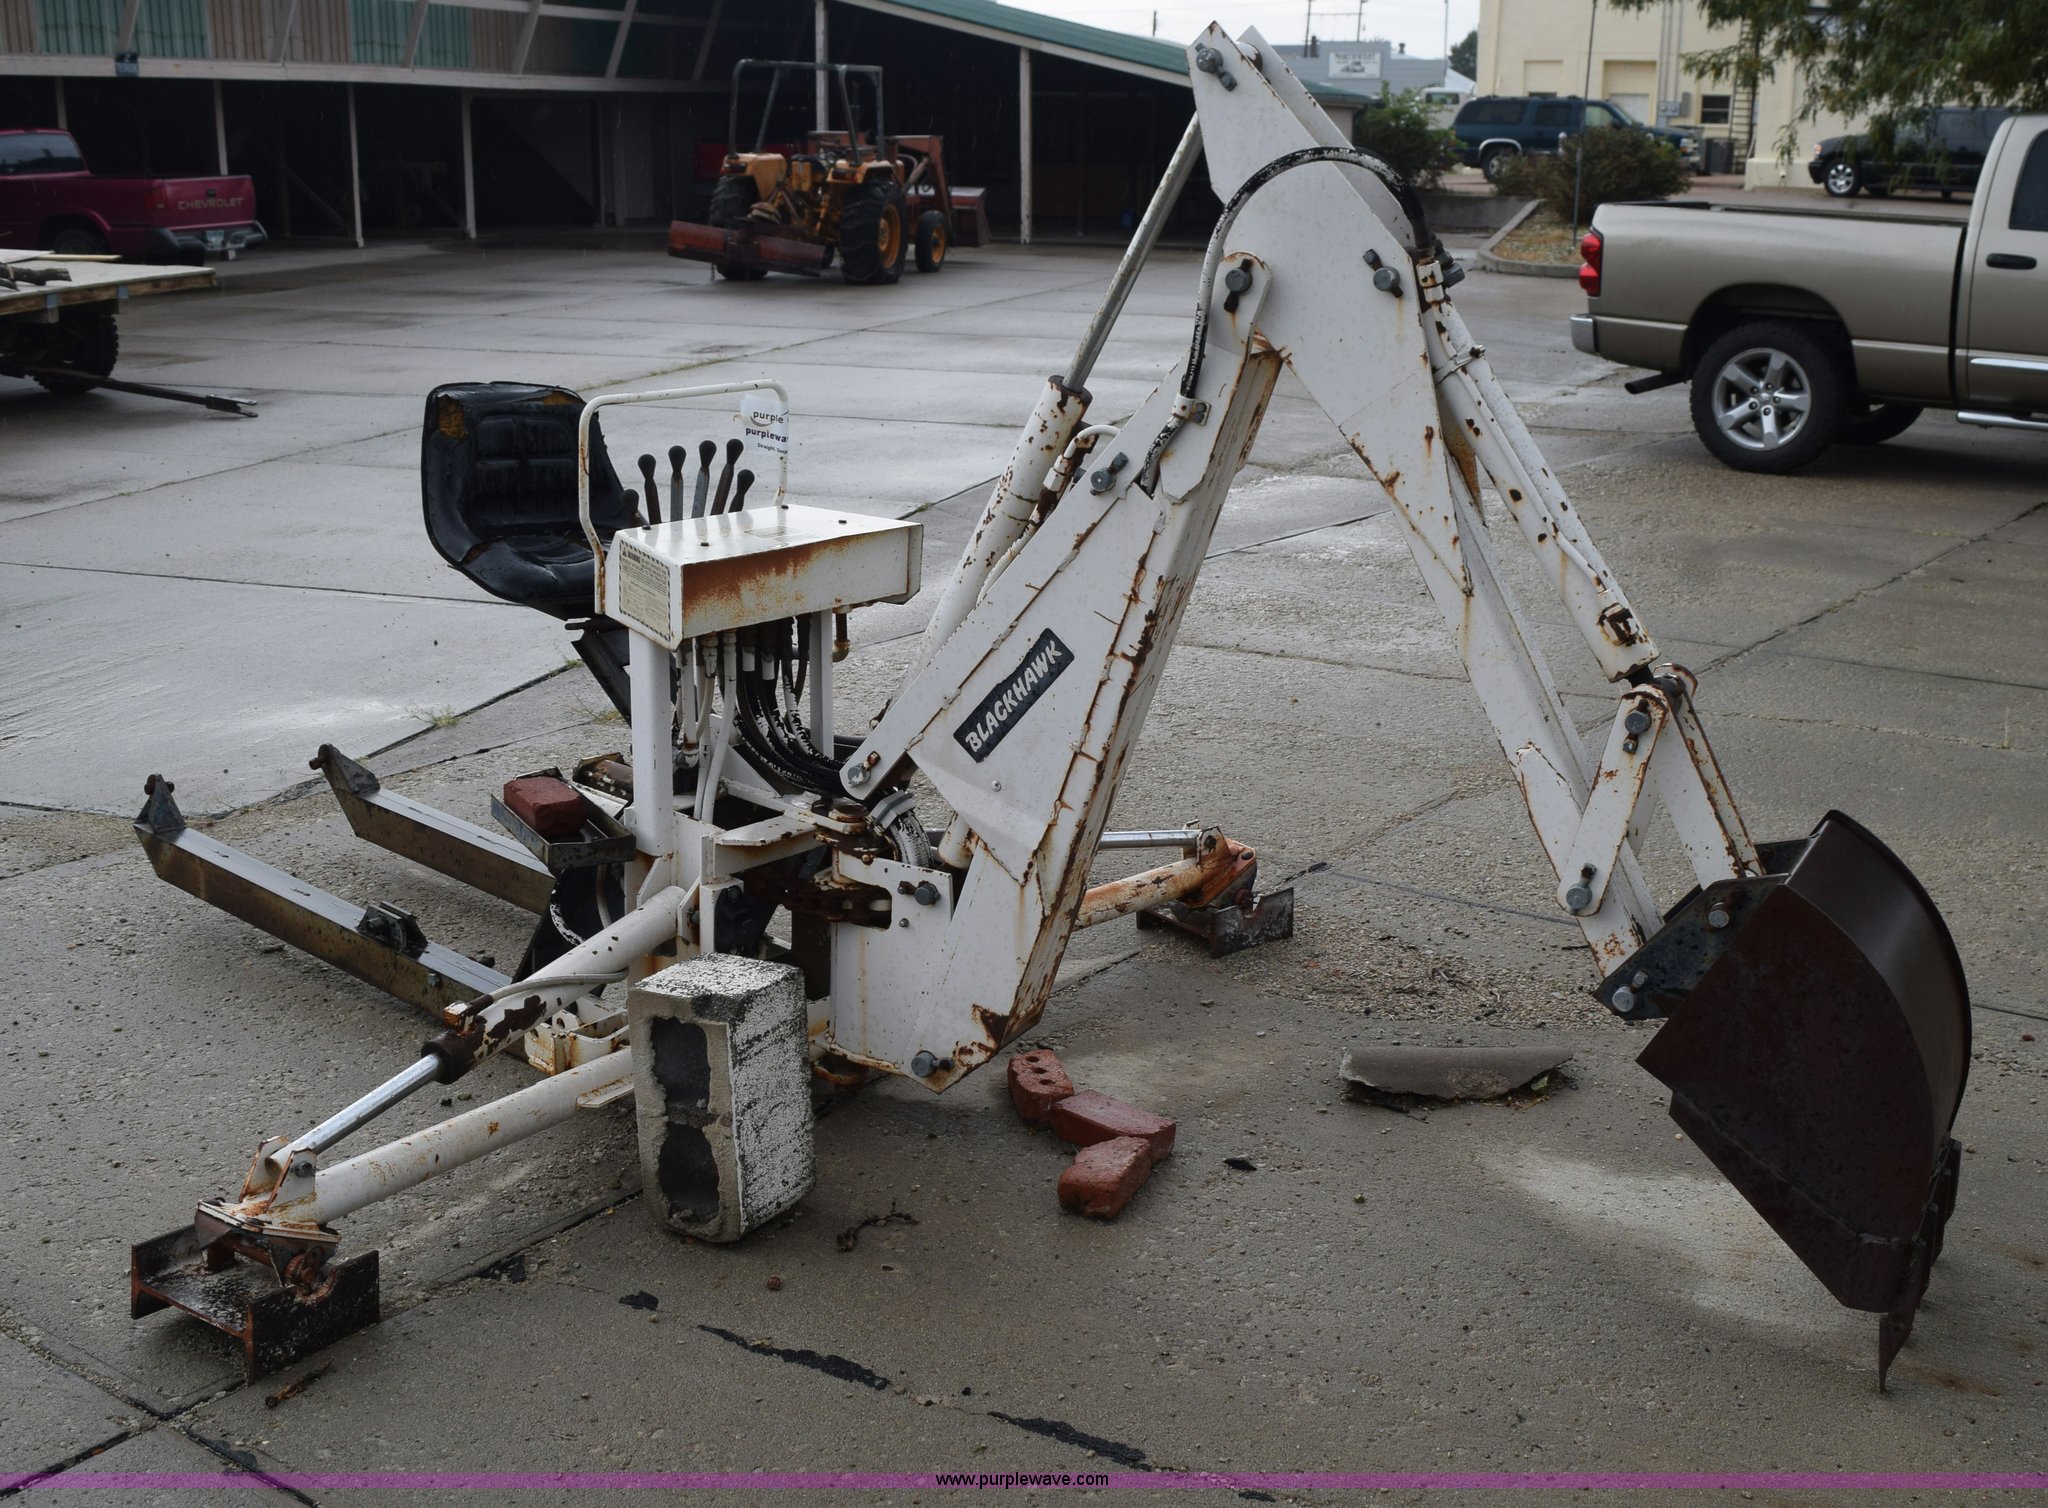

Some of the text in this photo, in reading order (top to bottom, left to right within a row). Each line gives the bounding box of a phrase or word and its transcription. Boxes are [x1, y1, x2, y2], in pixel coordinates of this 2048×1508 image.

[178, 197, 244, 210] CHEVROLET
[753, 411, 784, 424] purple
[745, 427, 789, 443] purplewa
[965, 640, 1063, 752] BLACKHAWK
